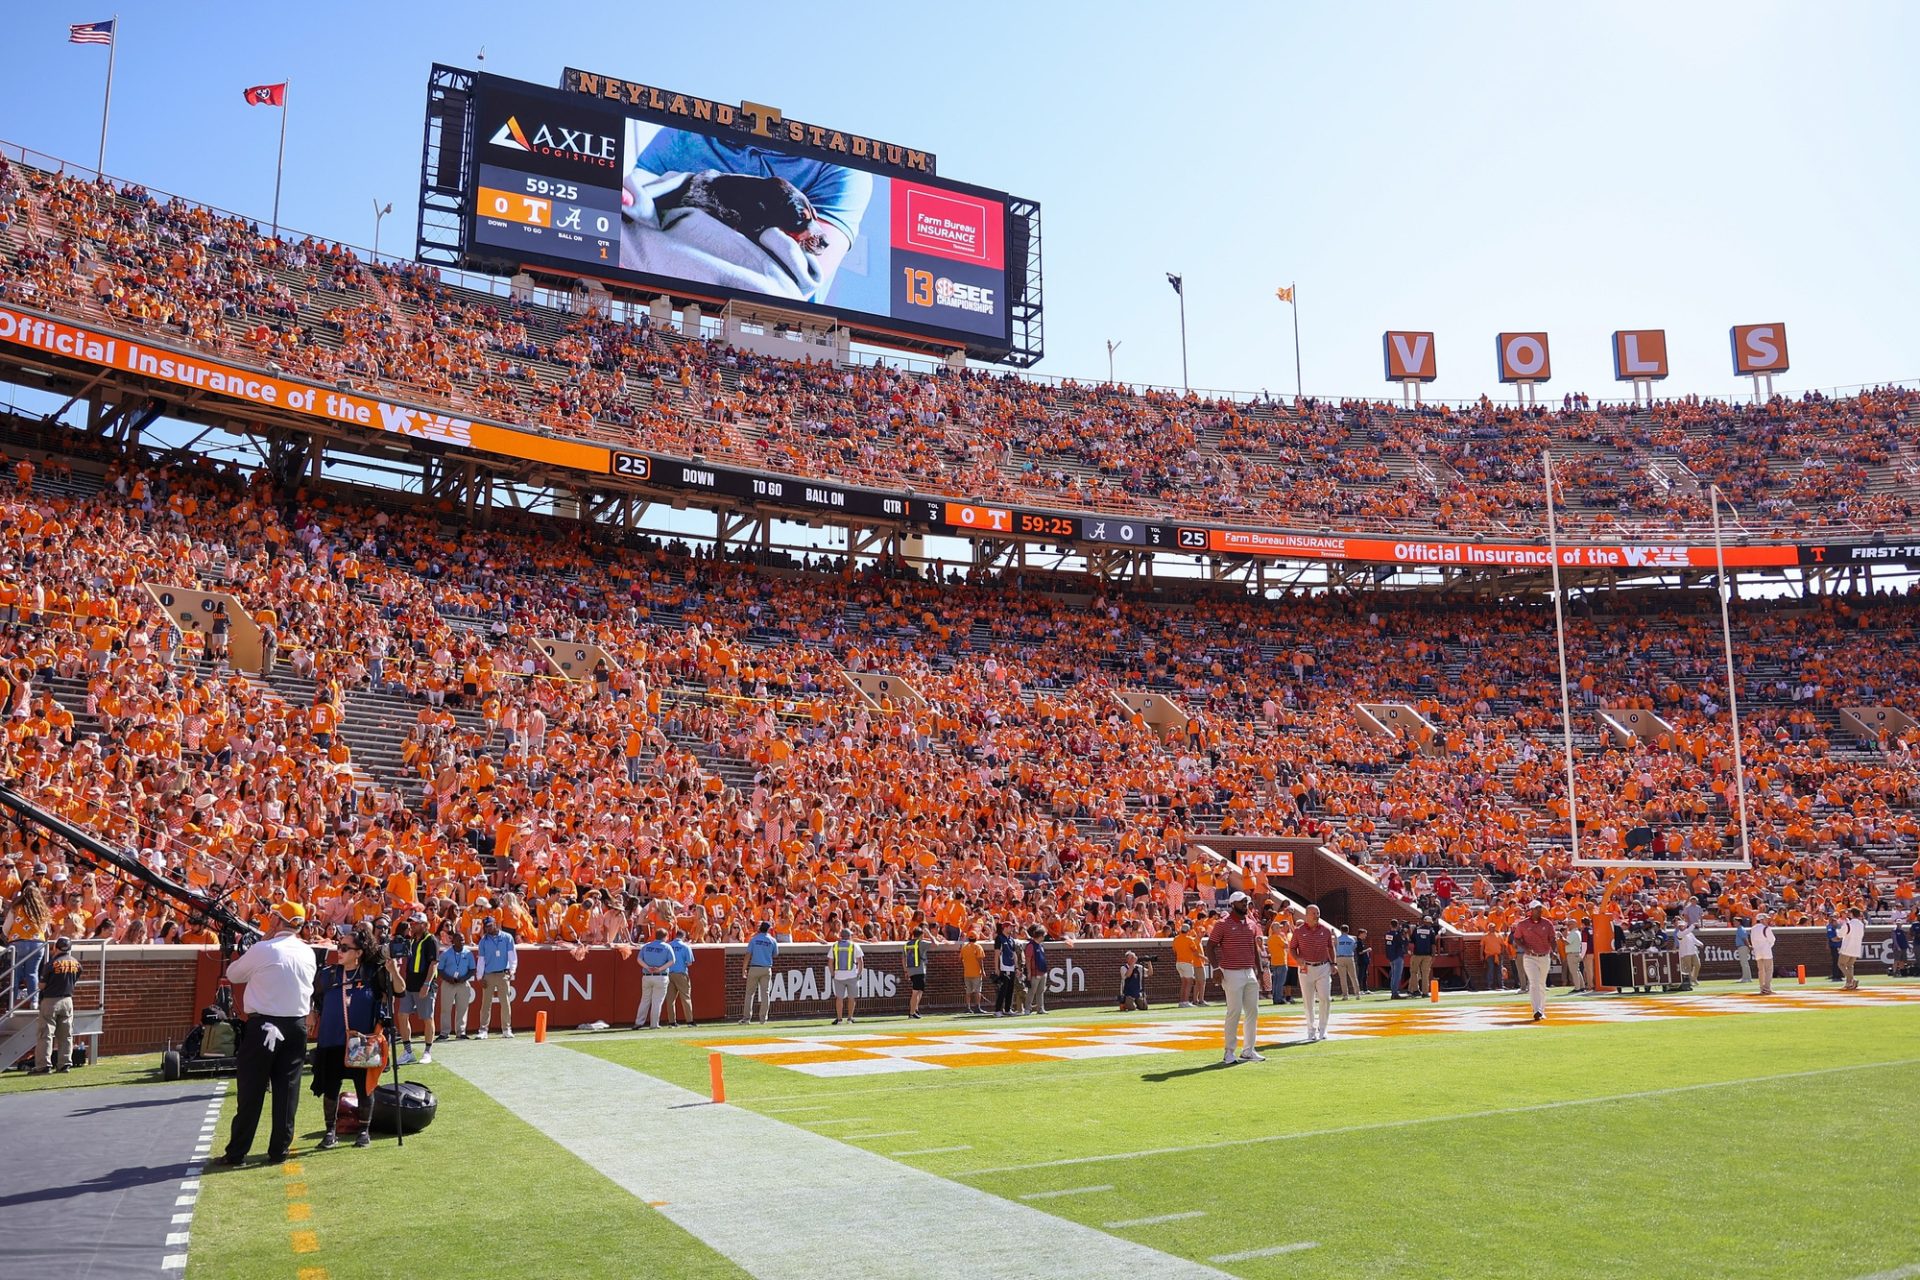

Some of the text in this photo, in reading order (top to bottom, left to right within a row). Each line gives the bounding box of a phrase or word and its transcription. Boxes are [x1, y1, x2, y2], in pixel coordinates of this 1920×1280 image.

[579, 72, 926, 171] NEYLAND T STADIUM
[532, 123, 616, 160] AXLE
[533, 143, 615, 168] LOGISTICS
[526, 177, 578, 200] 59:25
[494, 197, 508, 213] 0
[523, 198, 547, 223] T
[596, 216, 609, 232] 0
[918, 213, 976, 234] Farm Bureau
[488, 219, 508, 228] DOWN
[558, 232, 572, 240] BALL
[917, 223, 975, 244] INSURANCE
[600, 247, 608, 259] 1
[904, 267, 934, 308] 13
[953, 282, 994, 305] SEC
[937, 294, 994, 315] CHAMPIONSHIPS
[1393, 336, 1429, 373] V
[1624, 335, 1659, 372] L
[1746, 328, 1778, 367] S
[0, 311, 115, 364] Official
[128, 346, 277, 402] Insurance
[288, 388, 317, 411] of
[326, 396, 370, 423] the
[618, 456, 646, 475] 25
[682, 468, 910, 516] DOWN TO GO BALL ON QTR 1
[929, 510, 937, 520] 3
[961, 508, 1006, 529] 0 T
[1022, 515, 1073, 535] 59:25
[1120, 525, 1134, 541] 0
[1152, 534, 1160, 544] 3
[1182, 531, 1205, 547] 25
[1225, 533, 1345, 549] Farm Bureau INSURANCE
[1394, 543, 1460, 562] Official
[1467, 545, 1553, 564] Insurance
[1563, 547, 1583, 564] of
[1587, 547, 1618, 565] the
[1811, 547, 1826, 562] T
[712, 904, 725, 920] 16
